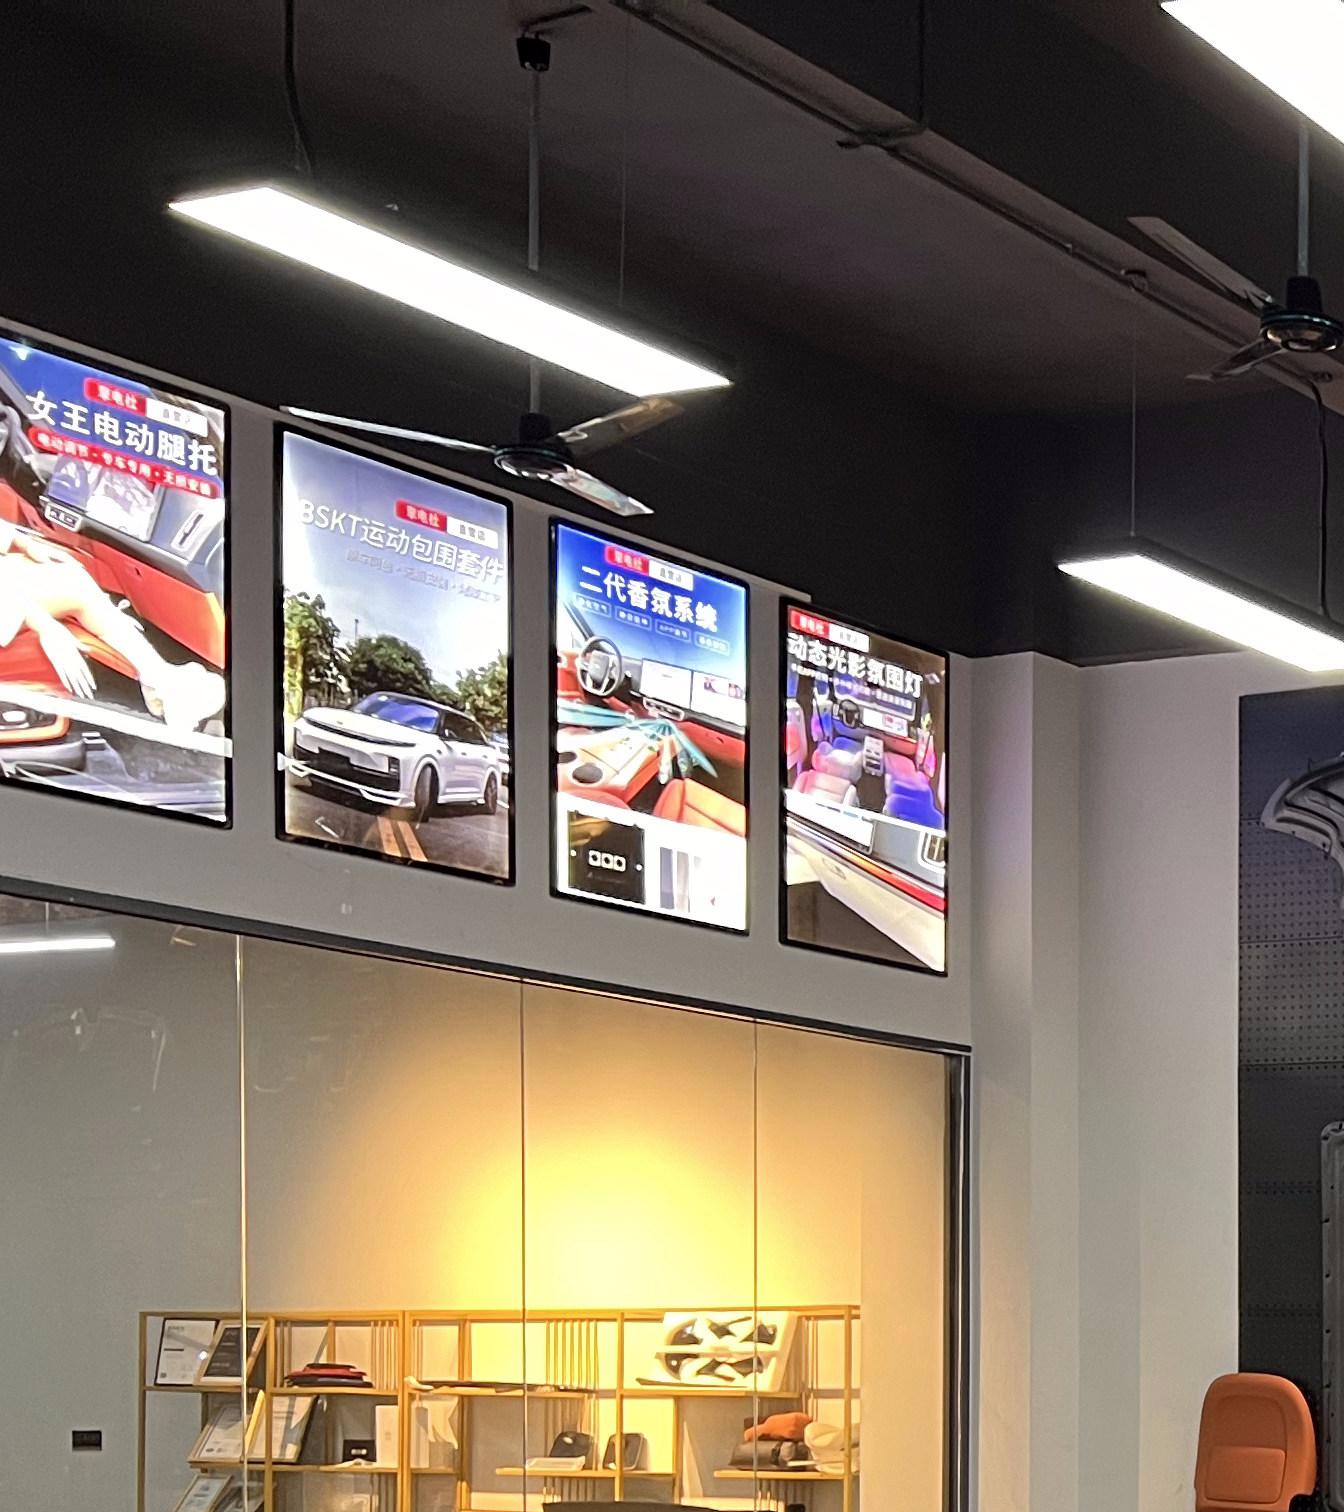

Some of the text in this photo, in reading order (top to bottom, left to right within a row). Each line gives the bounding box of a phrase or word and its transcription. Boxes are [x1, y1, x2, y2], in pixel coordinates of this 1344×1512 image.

[26, 391, 218, 475] 女王电动腿托
[301, 500, 504, 584] BSKT运动包围套件
[580, 565, 718, 632] 二代香氛系统
[787, 632, 923, 699] 动态光影氛围灯
